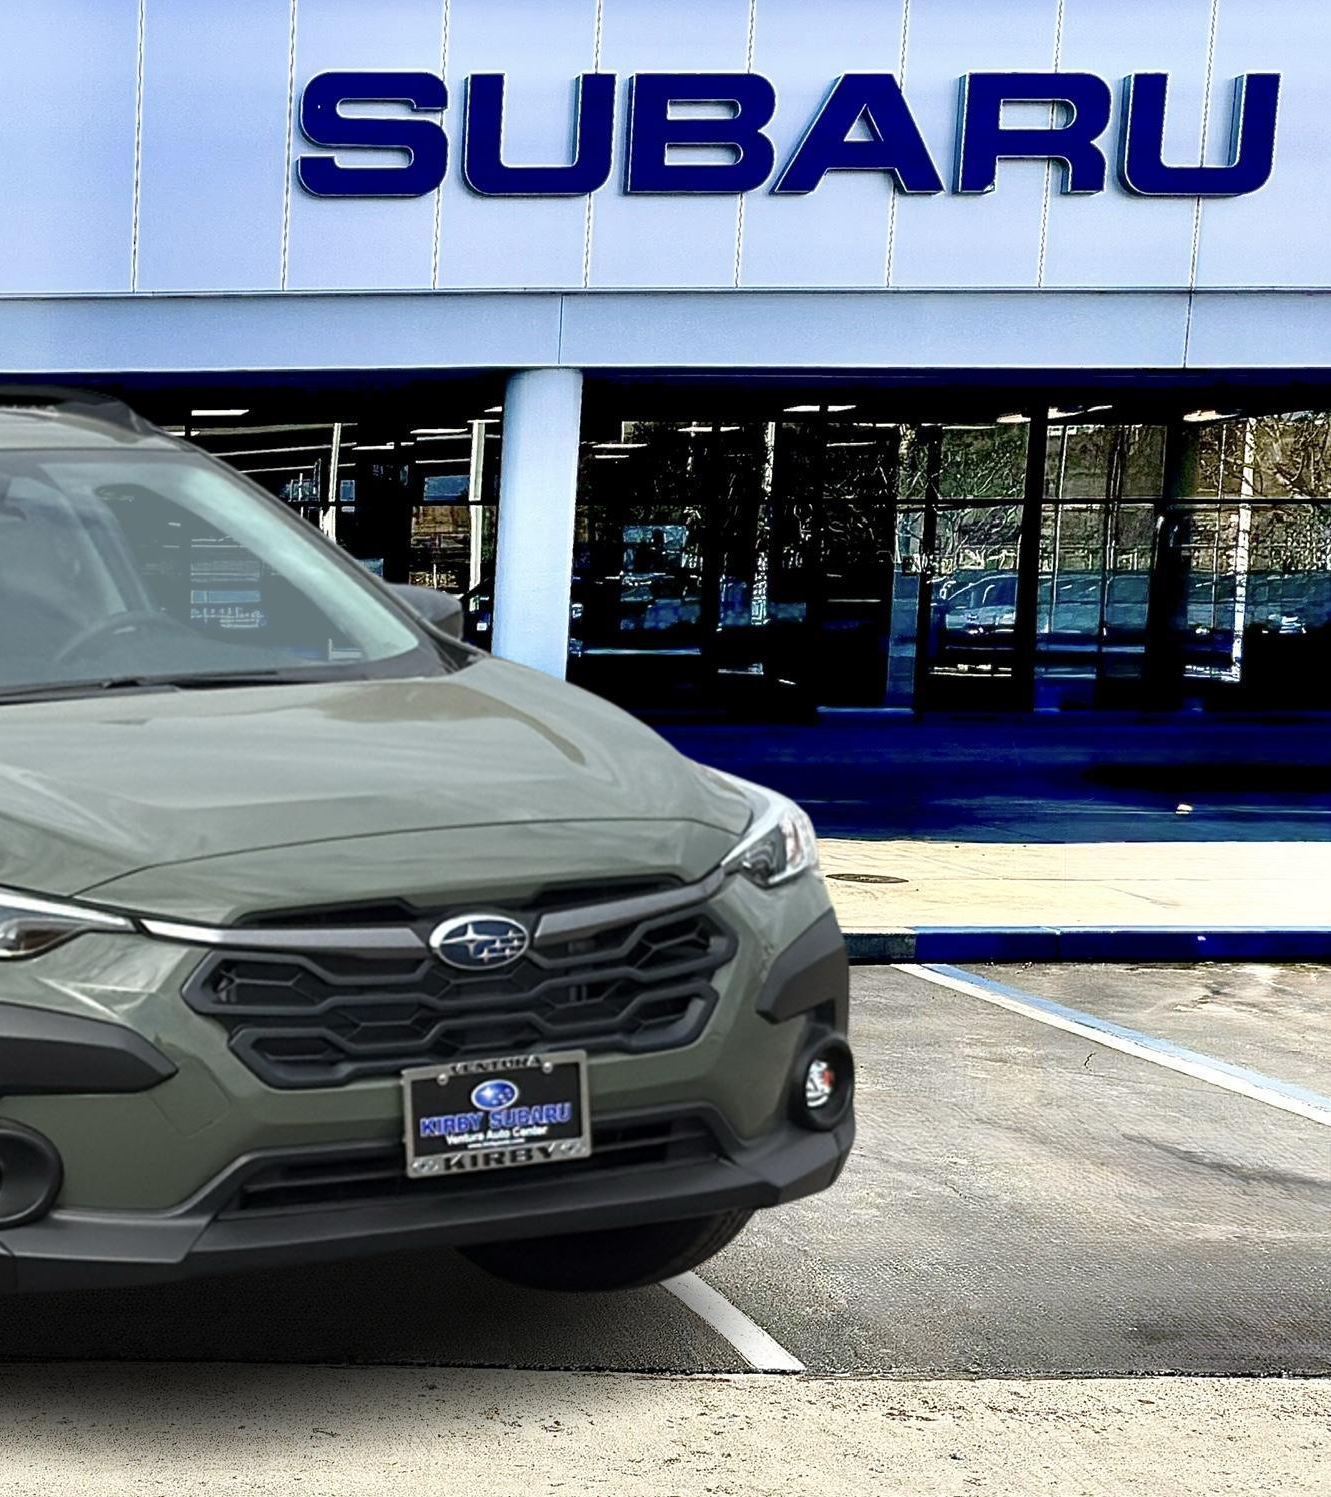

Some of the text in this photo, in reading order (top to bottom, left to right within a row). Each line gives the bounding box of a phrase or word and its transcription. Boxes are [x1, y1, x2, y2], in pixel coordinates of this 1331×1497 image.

[296, 70, 1281, 197] SUBARU
[450, 1055, 542, 1074] VENTURA
[420, 1102, 572, 1137] KIRBY SUBARU
[446, 1131, 485, 1145] Ventura
[486, 1128, 510, 1140] Auto
[512, 1125, 548, 1138] Center
[444, 1143, 554, 1171] KIRBY
